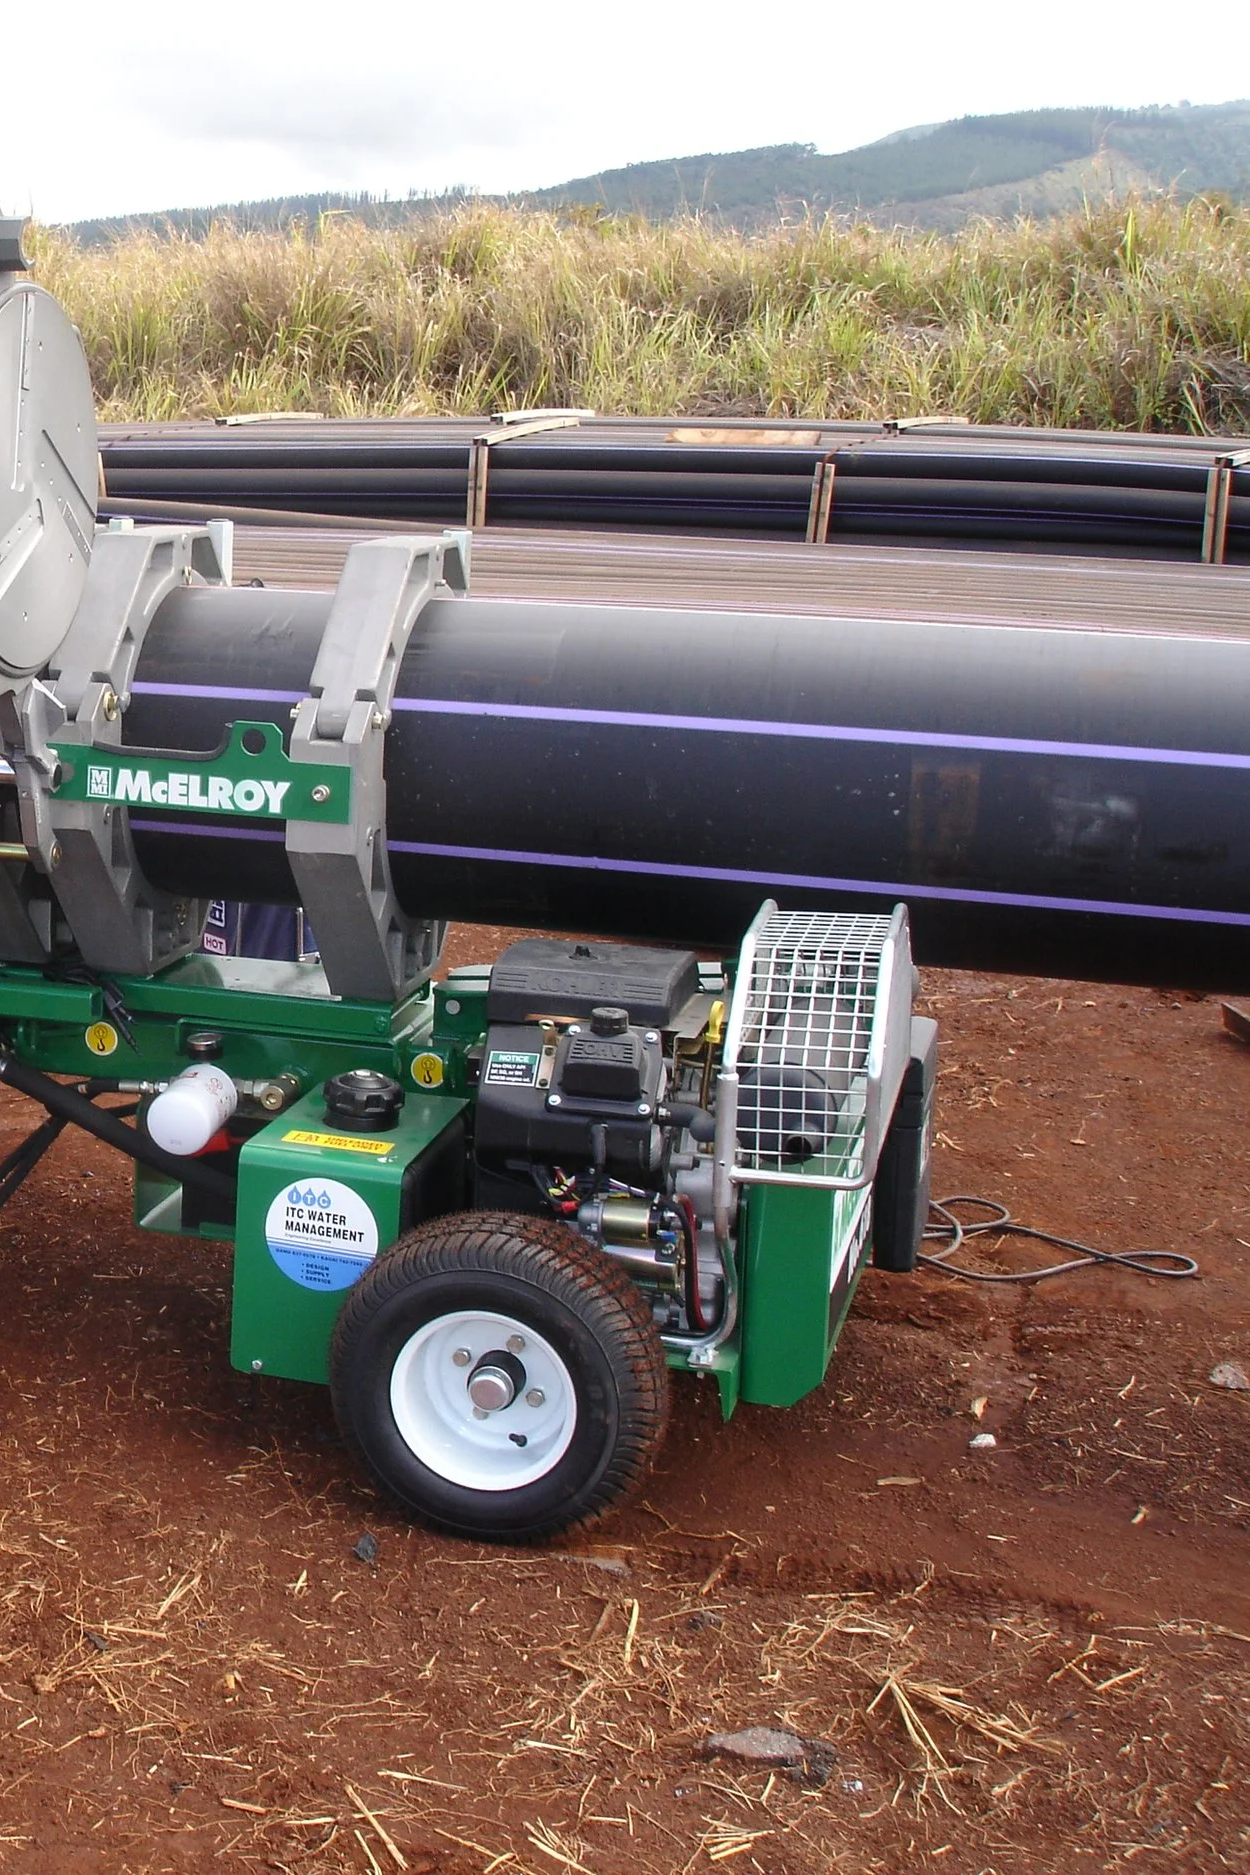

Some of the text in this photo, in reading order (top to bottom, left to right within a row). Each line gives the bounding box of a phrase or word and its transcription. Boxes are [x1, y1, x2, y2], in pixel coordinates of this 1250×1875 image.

[114, 768, 292, 814] McELROY
[205, 936, 224, 951] HOT
[529, 970, 621, 998] KOHLER
[498, 1054, 530, 1063] NOTICE
[286, 1206, 347, 1226] ITC WATER
[284, 1220, 365, 1243] MANAGEMENT
[305, 1263, 330, 1271] DESIGN
[305, 1269, 330, 1278] SUPPLY
[305, 1275, 331, 1285] SERVICE
